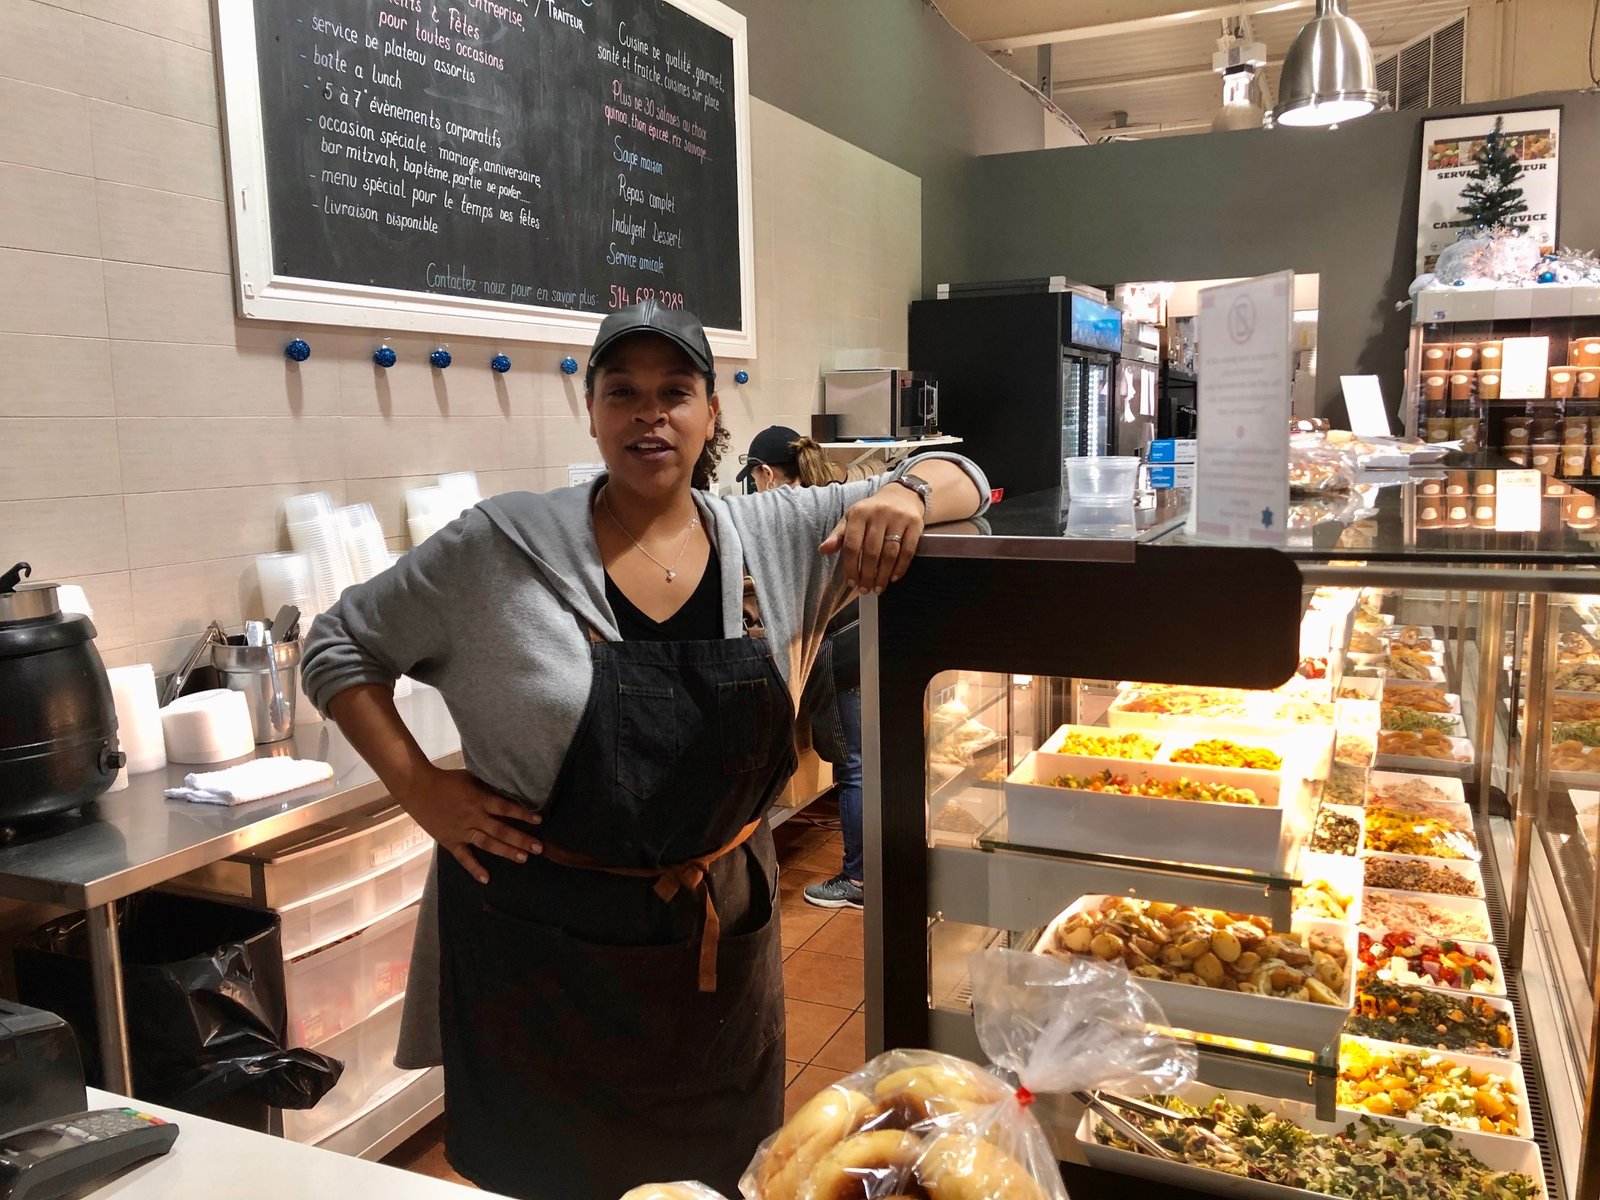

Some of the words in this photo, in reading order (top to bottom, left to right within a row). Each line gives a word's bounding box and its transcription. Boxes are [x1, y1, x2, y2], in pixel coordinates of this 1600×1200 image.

[312, 16, 358, 44] service
[384, 38, 426, 66] plateau
[434, 59, 476, 84] assortis
[379, 11, 407, 31] pour
[416, 20, 450, 51] toutes
[456, 42, 504, 71] occasions
[618, 21, 649, 55] Cuisine
[372, 63, 402, 90] lunch
[597, 45, 620, 67] santé
[622, 52, 630, 70] et
[704, 93, 720, 111] place
[340, 86, 349, 106] à
[446, 121, 502, 149] corporatifs
[612, 79, 632, 107] Plus
[643, 97, 655, 117] 30
[319, 115, 375, 141] occasion
[631, 113, 647, 134] thon
[321, 136, 343, 154] bar
[452, 173, 482, 190] partie
[613, 135, 638, 171] Soupe
[640, 155, 664, 175] maison
[322, 170, 358, 188] menu
[363, 177, 407, 199] spécial
[412, 188, 437, 208] pour
[444, 190, 454, 209] le
[461, 193, 493, 223] temps
[324, 195, 378, 222] livraison
[618, 173, 645, 206] Repas
[649, 192, 675, 216] complet
[611, 209, 646, 245] Indulgent
[652, 222, 681, 249] Dessert
[606, 242, 637, 268] Service
[639, 256, 664, 274] amicale
[511, 282, 533, 300] pour
[536, 286, 549, 301] en
[551, 289, 577, 305] savoir
[608, 284, 630, 310] 514
